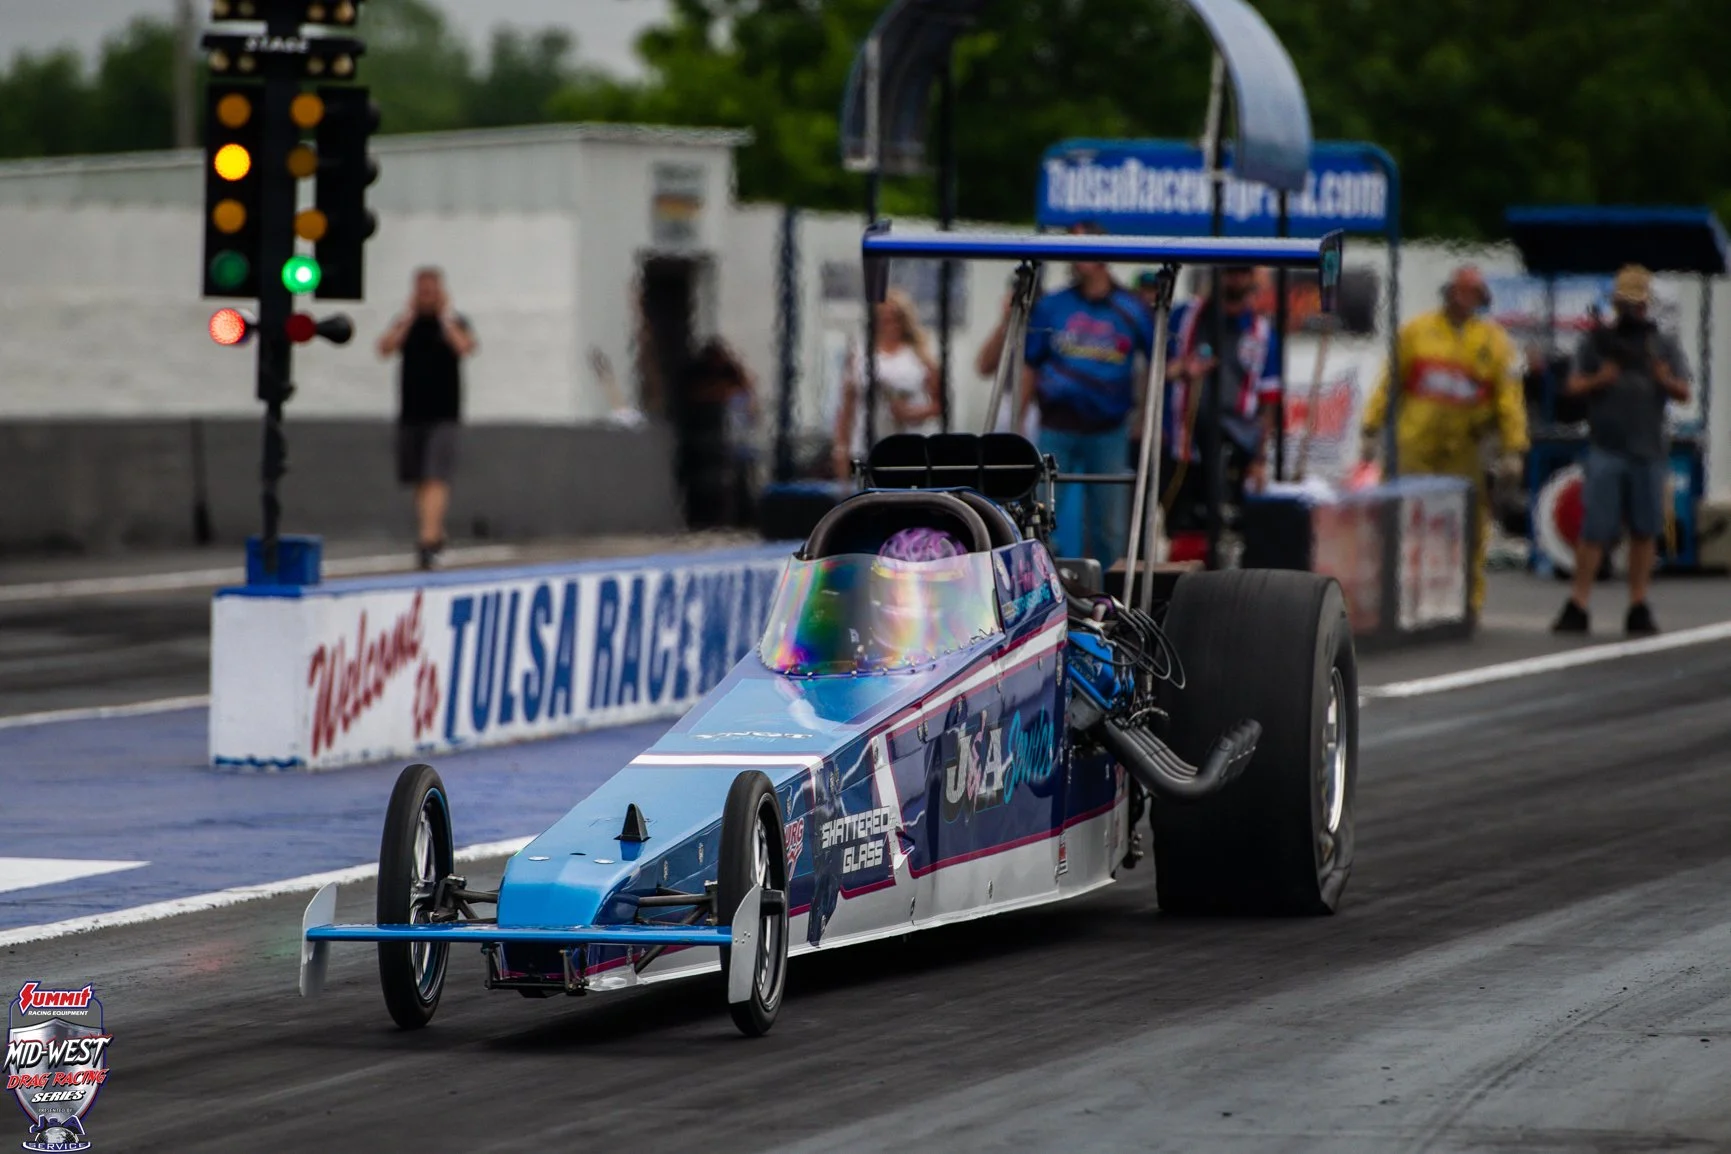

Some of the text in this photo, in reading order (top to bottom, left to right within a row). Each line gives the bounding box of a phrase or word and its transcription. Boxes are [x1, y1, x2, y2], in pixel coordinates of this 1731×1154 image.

[307, 586, 424, 757] Welcome
[414, 651, 441, 740] to
[443, 577, 578, 740] TULSA
[821, 806, 891, 849] SHATTERED
[842, 839, 884, 874] GLASS
